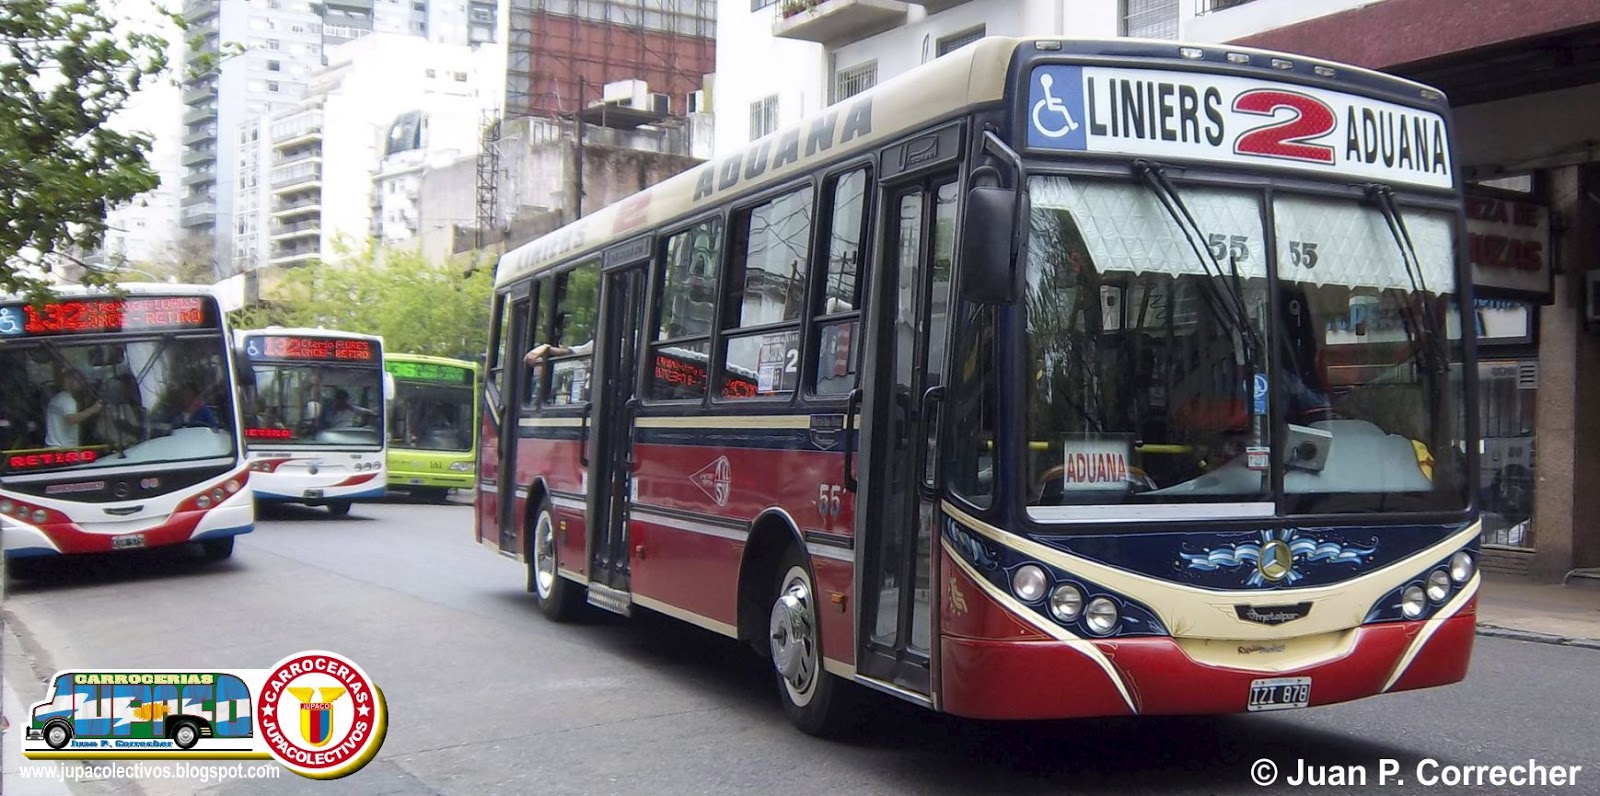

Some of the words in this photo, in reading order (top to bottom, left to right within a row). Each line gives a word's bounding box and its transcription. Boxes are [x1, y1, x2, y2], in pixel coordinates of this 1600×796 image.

[1087, 77, 1225, 147] LINIERS
[1231, 88, 1338, 166] 2
[1346, 105, 1448, 175] ADUANA
[693, 97, 874, 202] ADUANA
[1208, 233, 1248, 262] 55
[1289, 240, 1318, 269] 55
[23, 301, 87, 333] 132
[145, 309, 204, 325] RETIRO
[264, 337, 301, 357] 132
[335, 349, 370, 359] RETIRO
[785, 348, 799, 373] 2
[9, 451, 96, 468] RETIRO
[1067, 453, 1127, 483] ADUANA
[819, 484, 841, 517] 55
[1251, 687, 1277, 705] IZI
[1283, 685, 1308, 702] 878
